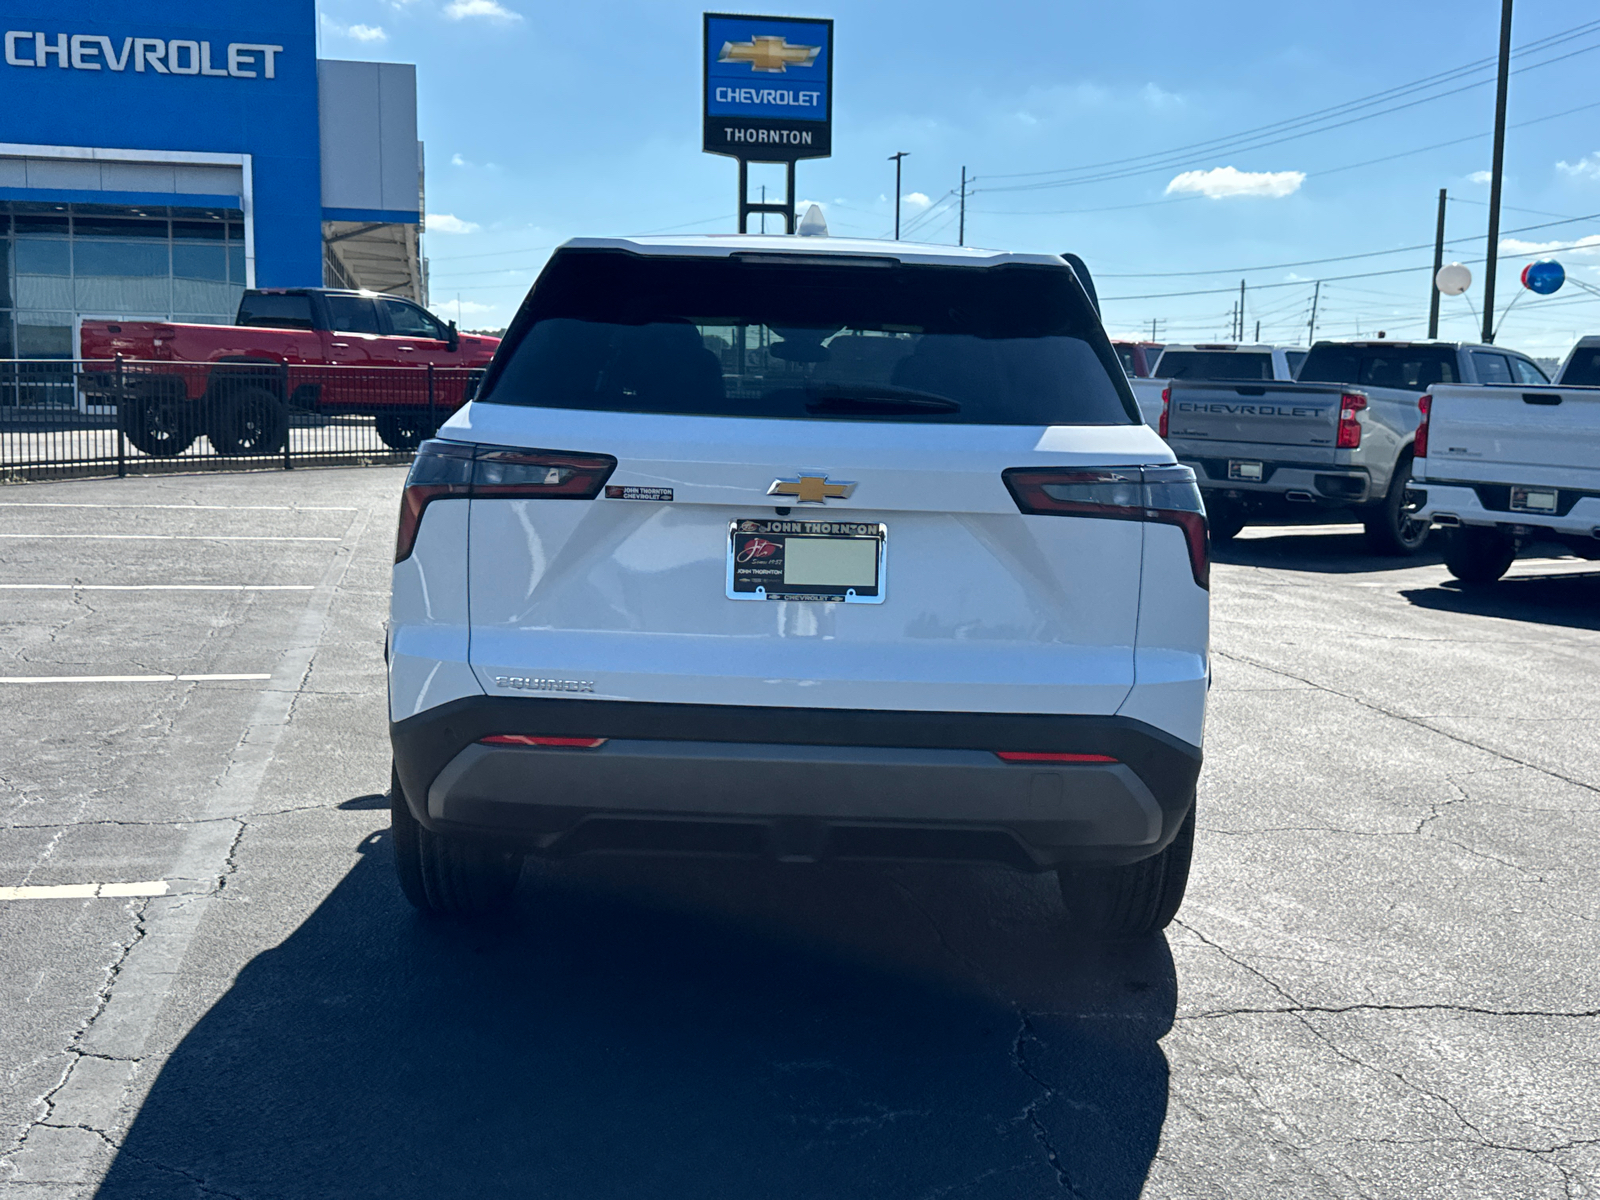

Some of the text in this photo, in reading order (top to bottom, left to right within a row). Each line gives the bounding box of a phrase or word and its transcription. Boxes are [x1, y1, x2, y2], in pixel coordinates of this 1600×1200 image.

[4, 30, 283, 79] CHEVROLET
[715, 86, 820, 107] CHEVROLET
[724, 127, 812, 145] THORNTON
[1179, 403, 1325, 417] CHEVROLET
[766, 521, 801, 533] JOHN
[495, 675, 595, 693] EQUINOX
